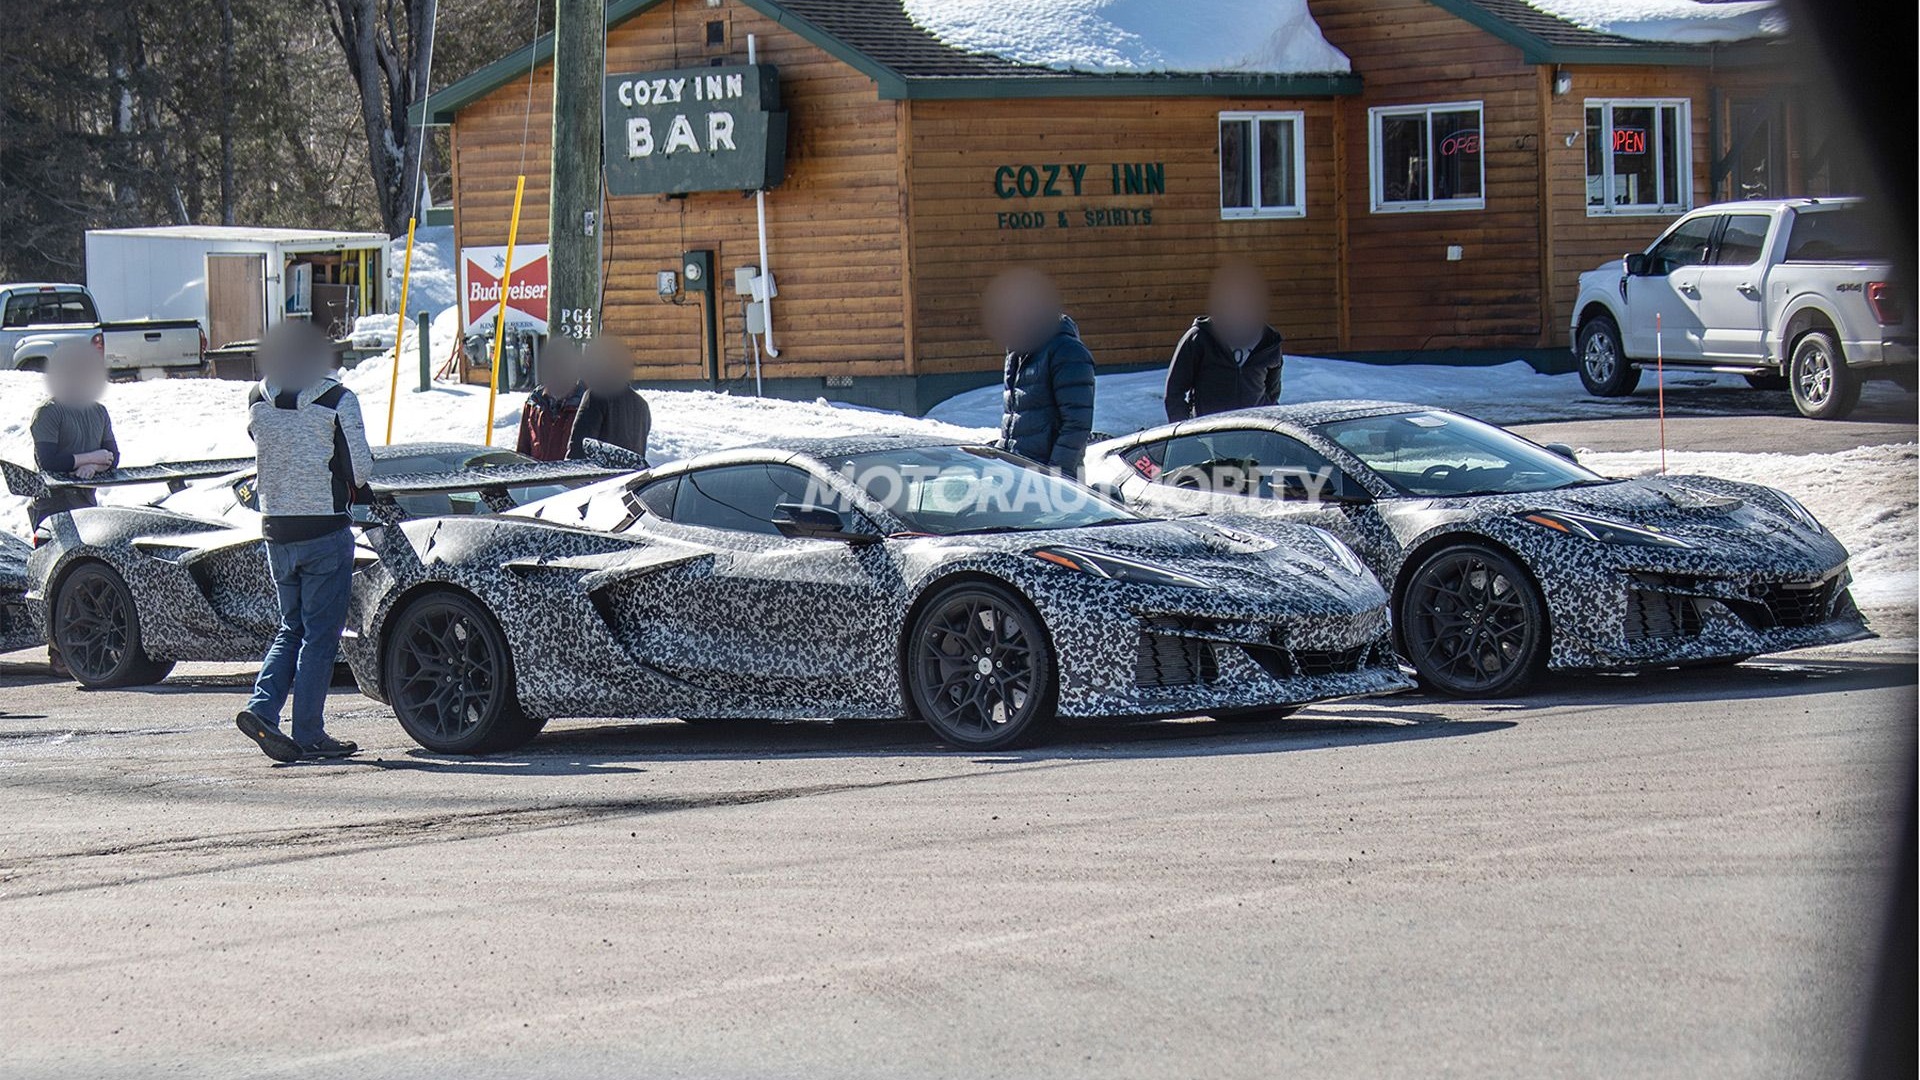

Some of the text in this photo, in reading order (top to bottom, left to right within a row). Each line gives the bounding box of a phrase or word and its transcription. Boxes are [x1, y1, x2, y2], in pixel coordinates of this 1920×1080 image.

[618, 73, 743, 107] COZY INN
[625, 111, 737, 159] BAR
[1442, 135, 1480, 155] OPE
[994, 162, 1165, 199] COZY INN
[997, 208, 1153, 229] FOOD & SPIRITS
[561, 308, 592, 323] PG4
[561, 324, 592, 339] 234
